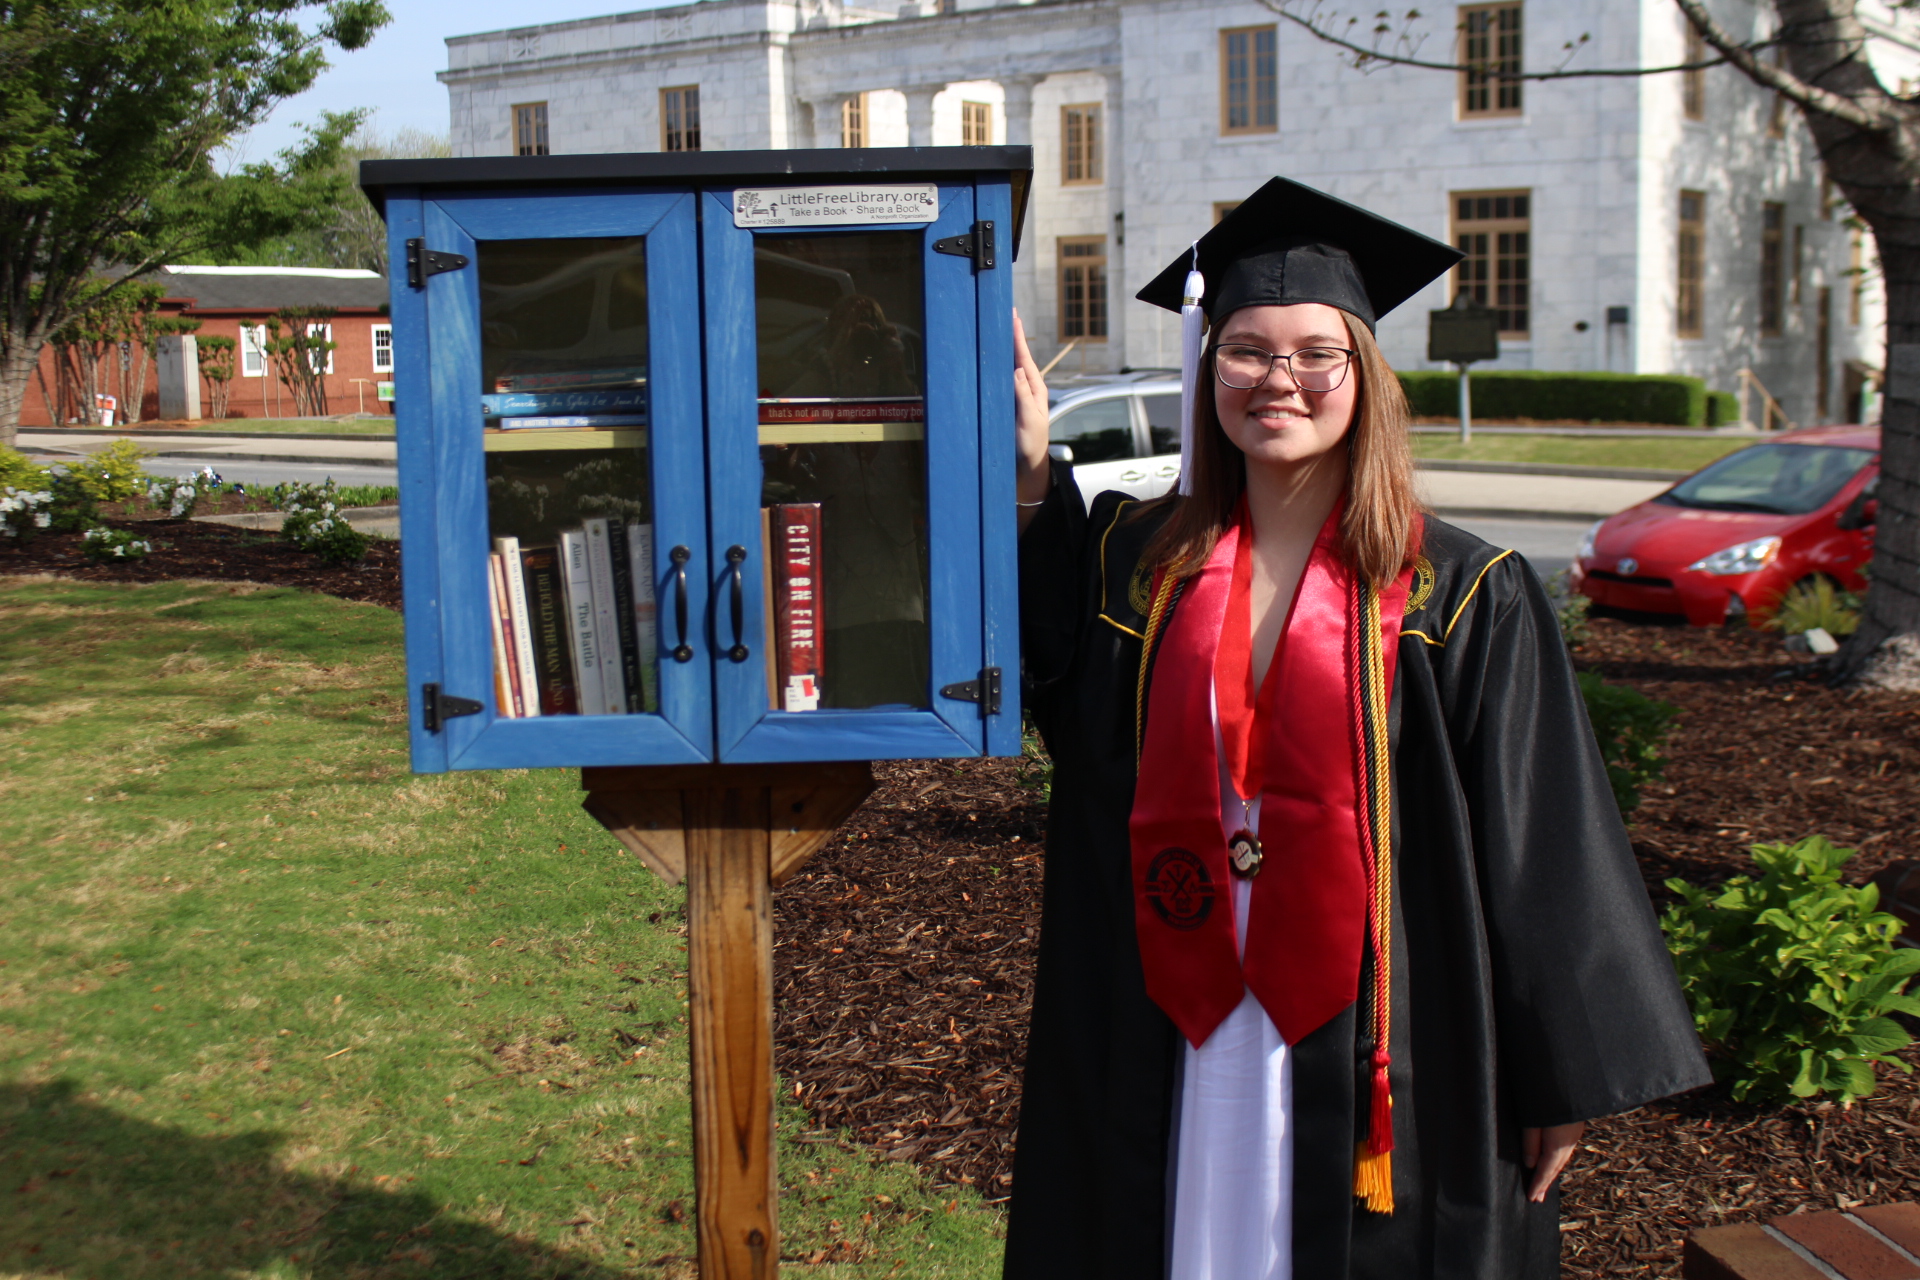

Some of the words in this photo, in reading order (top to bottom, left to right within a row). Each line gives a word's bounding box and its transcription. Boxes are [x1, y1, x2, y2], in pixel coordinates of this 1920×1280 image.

[780, 191, 927, 204] LittleFreeLibrary.org
[789, 208, 811, 216] Take
[823, 207, 847, 216] Book
[856, 205, 884, 214] Share
[896, 204, 920, 213] Book
[504, 396, 548, 409] Searching
[769, 407, 792, 417] that's
[795, 408, 808, 417] not
[811, 407, 820, 417] in
[822, 409, 834, 419] my
[837, 407, 876, 417] american
[880, 406, 908, 418] history
[573, 543, 581, 569] Allen
[640, 534, 652, 571] KAREN
[787, 525, 810, 566] CITY
[538, 574, 554, 620] BEHOLD
[789, 577, 812, 600] ON
[578, 602, 589, 627] The
[543, 621, 558, 645] THE
[790, 609, 813, 648] FIRE
[546, 648, 560, 672] MAN
[582, 631, 595, 667] Battle
